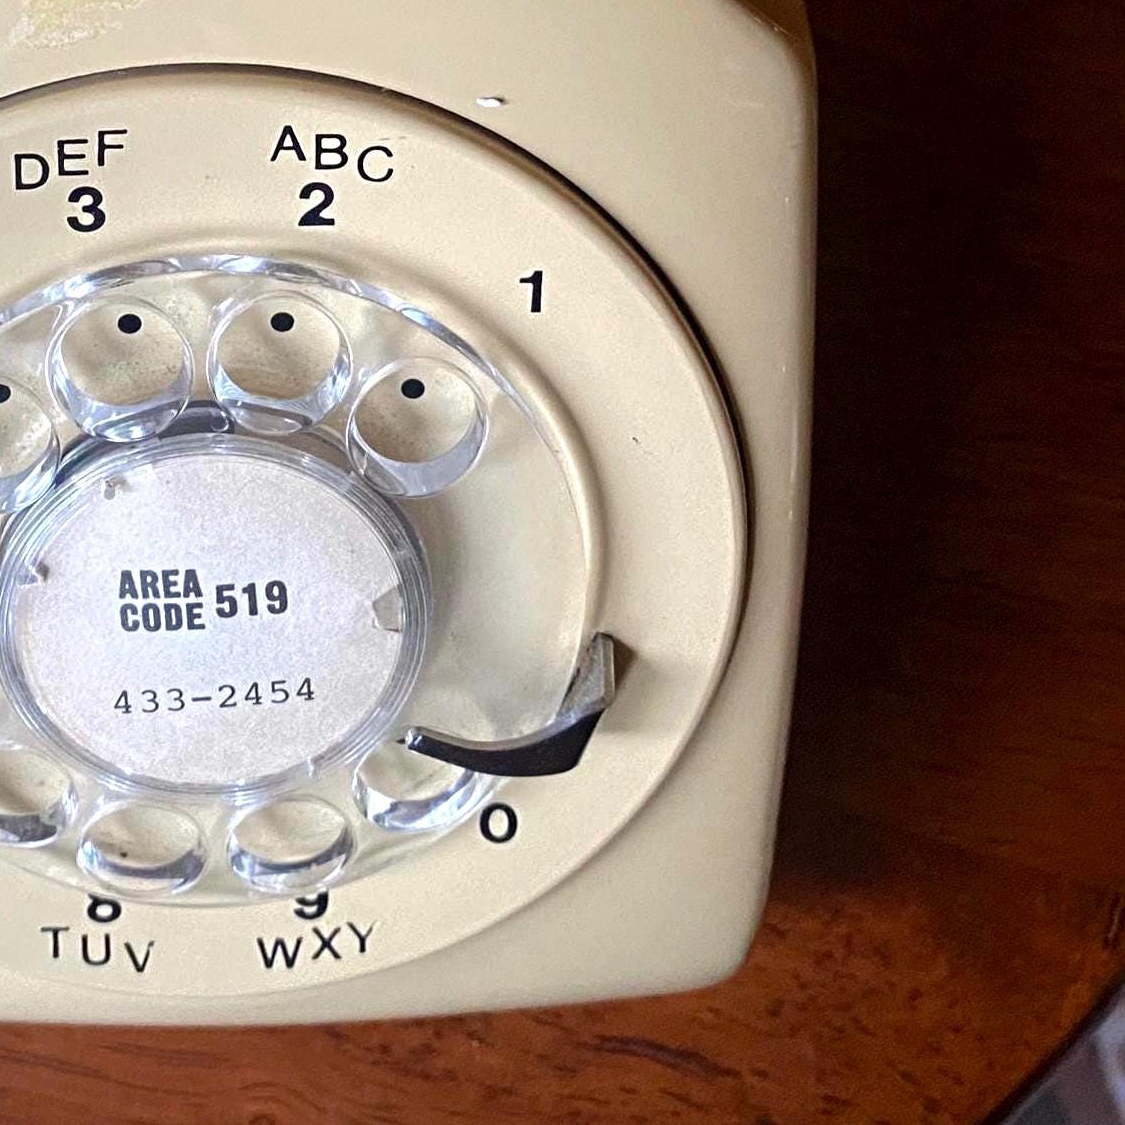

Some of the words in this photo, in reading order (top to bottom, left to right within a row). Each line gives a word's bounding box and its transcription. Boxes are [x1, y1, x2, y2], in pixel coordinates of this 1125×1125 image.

[13, 128, 128, 192] DEF
[270, 124, 394, 186] ABC
[66, 185, 106, 233] 3
[297, 181, 336, 227] 2
[519, 270, 543, 313] 1
[118, 569, 204, 600] AREA
[119, 602, 206, 632] CODE
[215, 580, 288, 619] 519
[114, 677, 315, 714] 433-2454
[40, 926, 155, 974] TUV
[256, 922, 373, 970] WXY
